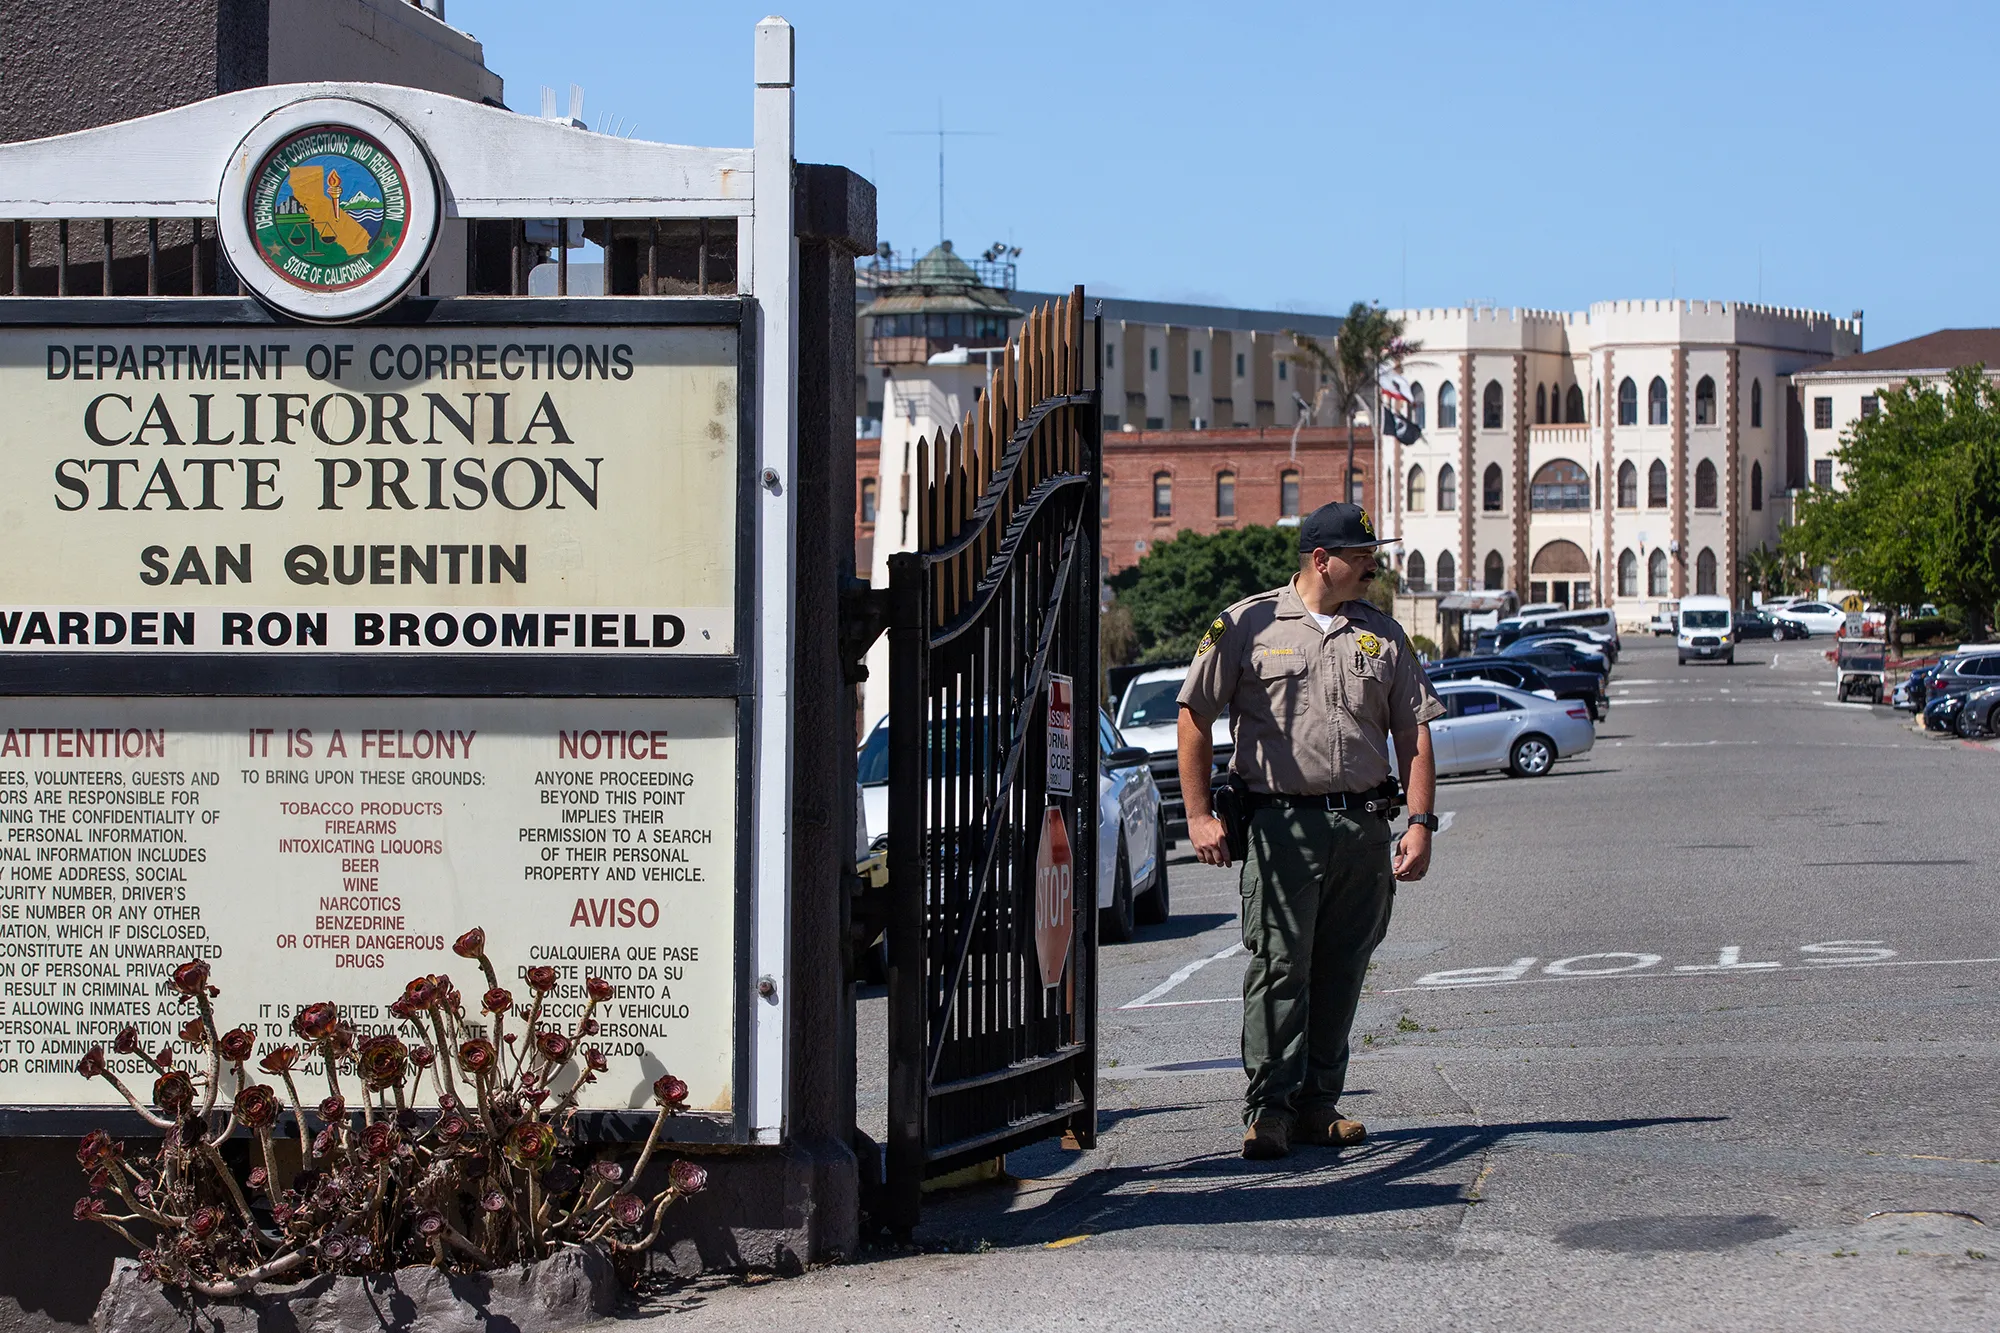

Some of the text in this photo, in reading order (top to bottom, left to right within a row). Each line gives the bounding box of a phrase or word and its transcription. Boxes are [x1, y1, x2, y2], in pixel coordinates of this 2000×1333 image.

[255, 133, 405, 230] DEPARTMENT OF CORRECTIONS AND REHABILITATION
[282, 256, 375, 286] STATE OF CALIFORNIA
[46, 344, 635, 381] DEPARTMENT OF CORRECTIONS
[84, 391, 575, 446] CALIFORNIA
[54, 457, 604, 511] STATE PRISON
[140, 544, 526, 586] SAN QUENTIN
[222, 612, 327, 646] RON
[355, 613, 685, 647] BROOMFIELD
[1, 728, 164, 758] ATTENTION
[250, 728, 476, 759] IT IS A FELONY
[559, 730, 667, 760] NOTICE
[1050, 754, 1071, 771] CODE
[35, 771, 125, 788] VOLUNTEERS,
[132, 771, 184, 785] GUESTS
[191, 772, 219, 785] AND
[241, 770, 485, 785] TO BRING UPON THESE GROUNDS:
[535, 771, 693, 786] ANYONE PROCEEDING
[0, 790, 199, 805] ORS ARE RESPONSIBLE FOR
[541, 790, 685, 805] BEYOND THIS POINT
[280, 802, 442, 815] TOBACCO PRODUCTS
[39, 810, 65, 823] THE
[73, 810, 195, 824] CONFIDENTIALITY
[202, 810, 220, 824] OF
[562, 809, 663, 824] IMPLIES THEIR
[326, 820, 396, 834] FIREARMS
[9, 828, 83, 842] PERSONAL
[89, 829, 186, 843] INFORMATION.
[520, 828, 711, 843] PERMISSION TO A SEARCH
[280, 839, 442, 854] INTOXICATING LIQUORS
[0, 847, 206, 862] NAL INFORMATION INCLUDES
[541, 847, 689, 862] OF THEIR PERSONAL
[342, 859, 378, 872] BEER
[11, 867, 52, 880] HOME
[59, 867, 129, 883] ADDRESS,
[136, 867, 187, 881] SOCIAL
[525, 866, 704, 881] PROPERTY AND VEHICLE.
[343, 878, 378, 891] WINE
[53, 886, 115, 903] NUMBER,
[123, 887, 185, 901] DRIVER'S
[1037, 864, 1070, 930] STOP
[320, 897, 400, 911] NARCOTICS
[0, 905, 200, 920] SE NUMBER OR ANY OTHER
[570, 898, 659, 928] AVISO
[316, 916, 404, 930] BENZEDRINE
[56, 925, 102, 938] WHICH
[110, 925, 120, 938] IF
[127, 925, 209, 942] DISCLOSED,
[277, 934, 444, 950] OR OTHER DANGEROUS
[89, 944, 108, 958] AN
[115, 944, 222, 959] UNWARRANTED
[530, 946, 698, 961] CUALQUIERA QUE PASE
[336, 954, 384, 968] DRUGS
[1414, 939, 1898, 986] STOP
[22, 963, 40, 977] OF
[46, 963, 120, 977] PERSONAL
[127, 964, 179, 977] PRIVAC
[585, 966, 633, 980] PUNTO
[639, 966, 657, 980] DA
[664, 966, 682, 980] SU
[5, 982, 57, 996] RESULT
[63, 983, 75, 996] IN
[82, 982, 149, 996] CRIMINAL
[661, 986, 671, 999] A
[12, 1001, 83, 1015] ALLOWING
[90, 1002, 150, 1016] INMATES
[260, 1004, 271, 1018] IT
[278, 1004, 289, 1018] IS
[604, 1004, 612, 1018] Y
[619, 1004, 689, 1018] VEHICULO
[264, 1023, 282, 1037] TO
[601, 1024, 667, 1038] ERSONAL
[17, 1040, 35, 1054] TO
